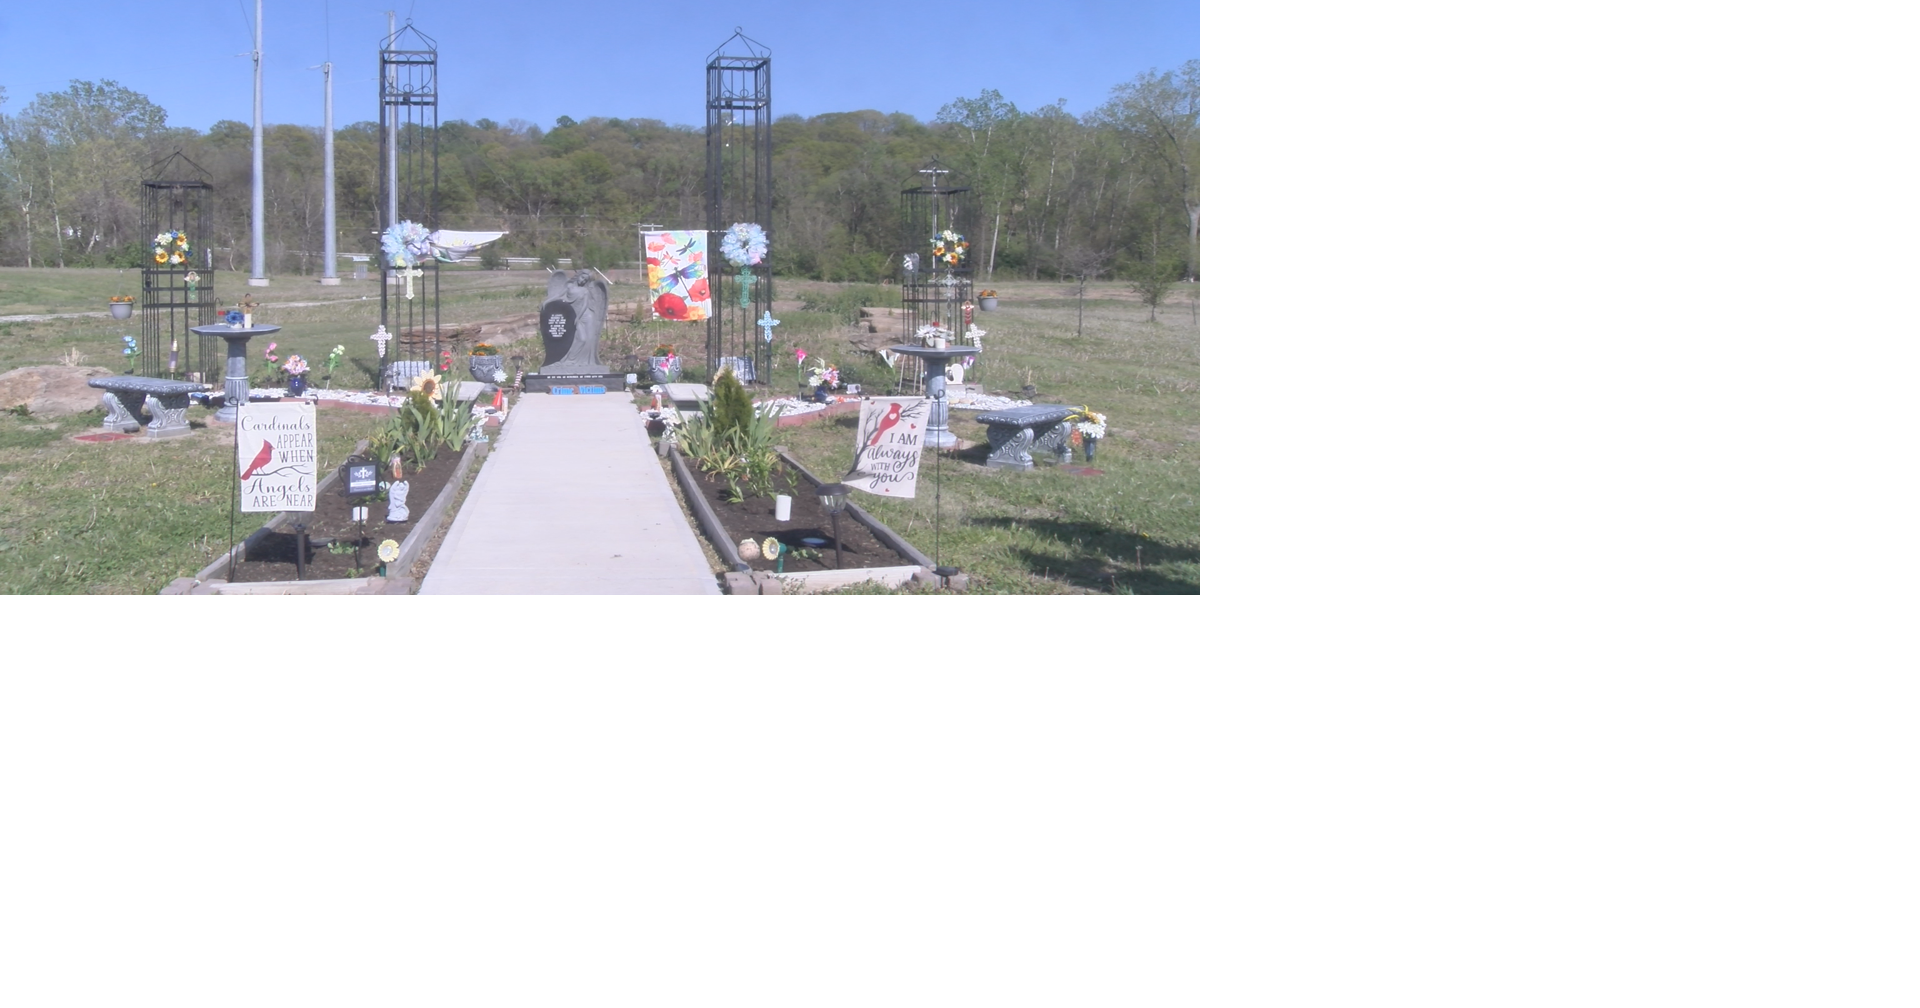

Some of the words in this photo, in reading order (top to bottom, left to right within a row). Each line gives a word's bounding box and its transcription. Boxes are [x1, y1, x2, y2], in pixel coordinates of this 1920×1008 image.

[241, 415, 311, 431] Cardinals
[277, 433, 313, 448] APPEAR
[889, 433, 895, 443] I
[897, 433, 918, 445] AM
[278, 450, 313, 463] WHEN
[870, 462, 890, 471] WITH
[866, 472, 914, 489] you
[243, 476, 311, 501] Angels
[253, 495, 277, 507] ARE
[286, 494, 313, 507] NEAR
